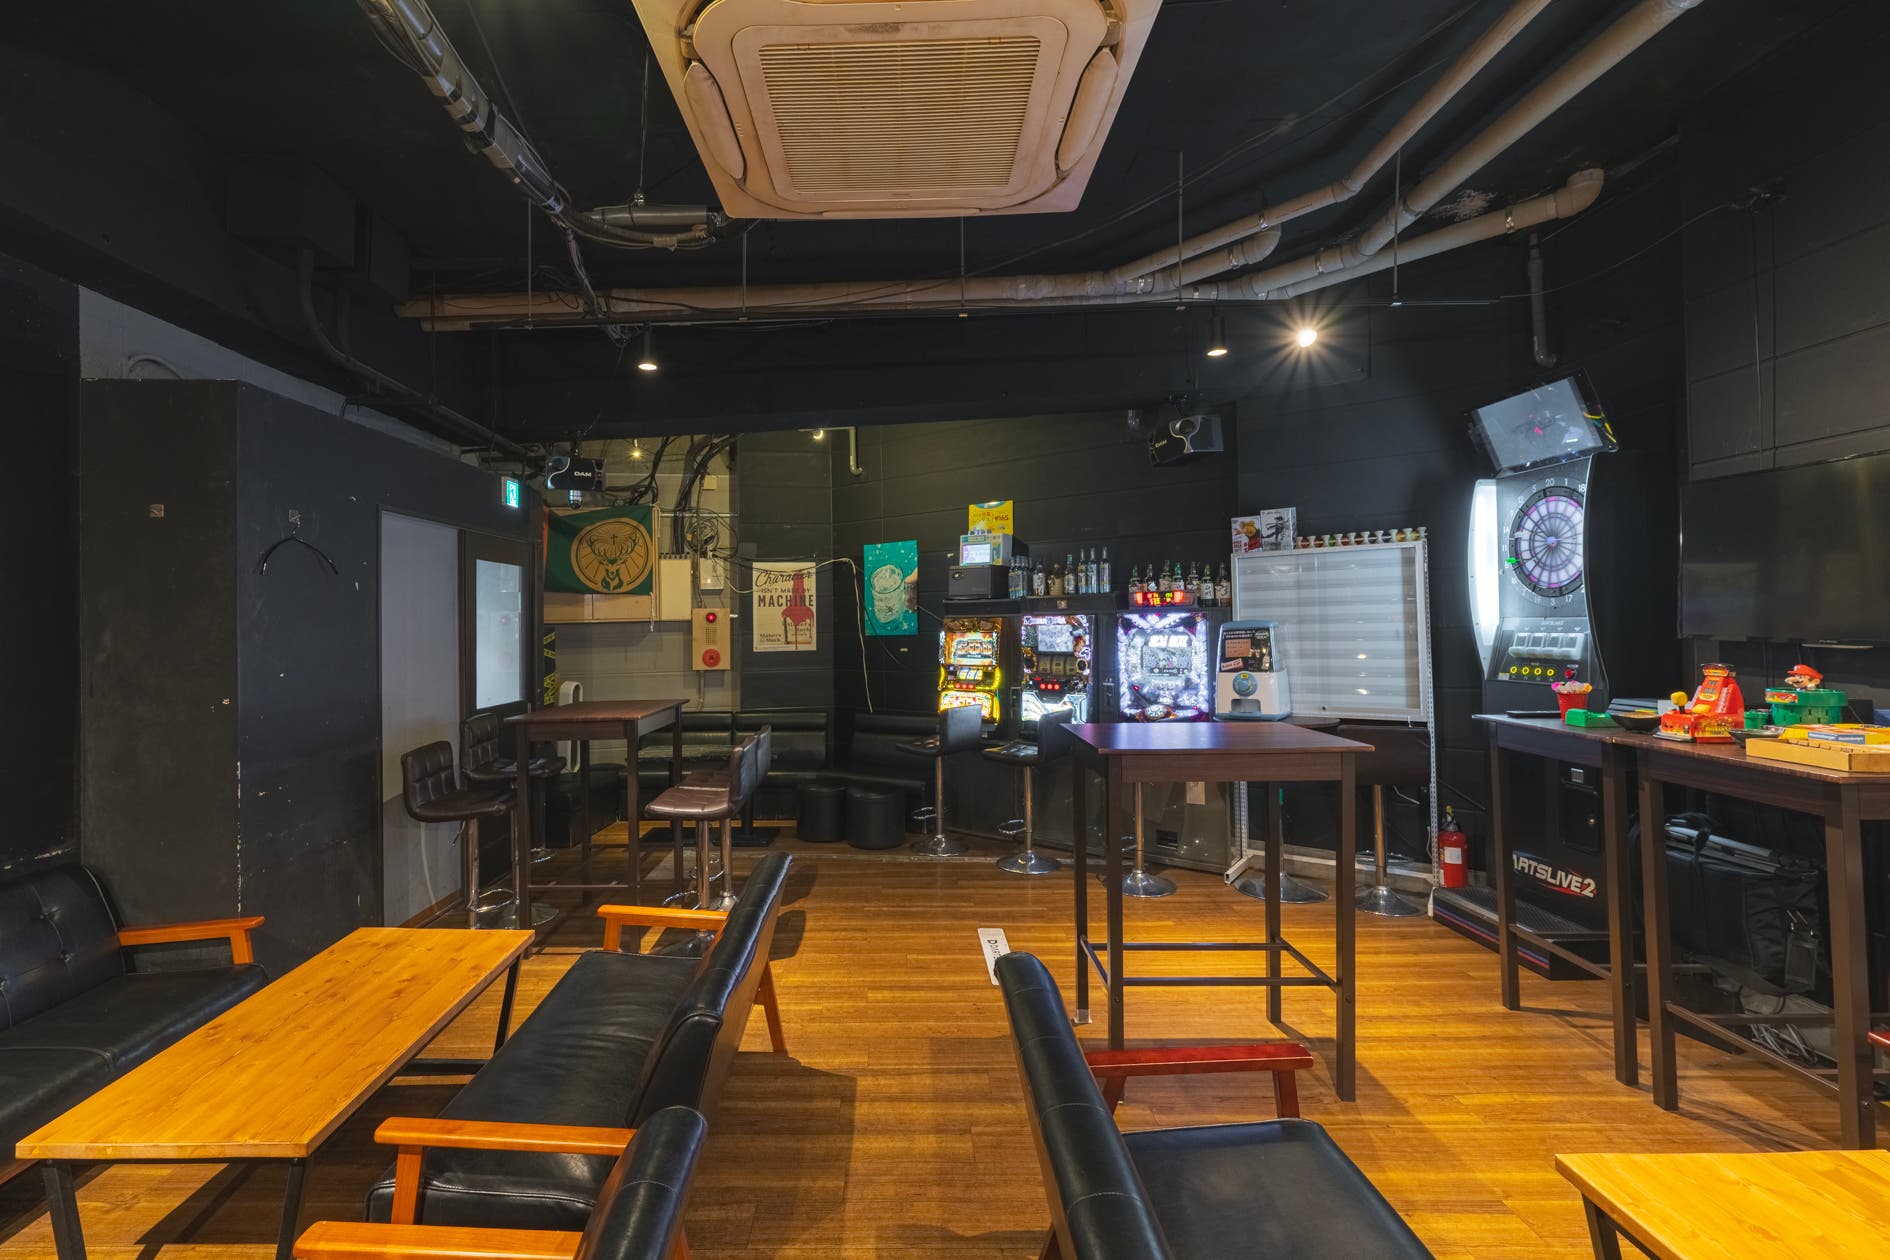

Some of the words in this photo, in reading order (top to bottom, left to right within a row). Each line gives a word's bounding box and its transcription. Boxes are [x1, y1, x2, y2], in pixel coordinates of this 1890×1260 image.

[1545, 478, 1555, 487] 20
[1578, 484, 1586, 492] 18
[757, 594, 815, 608] MACHINE
